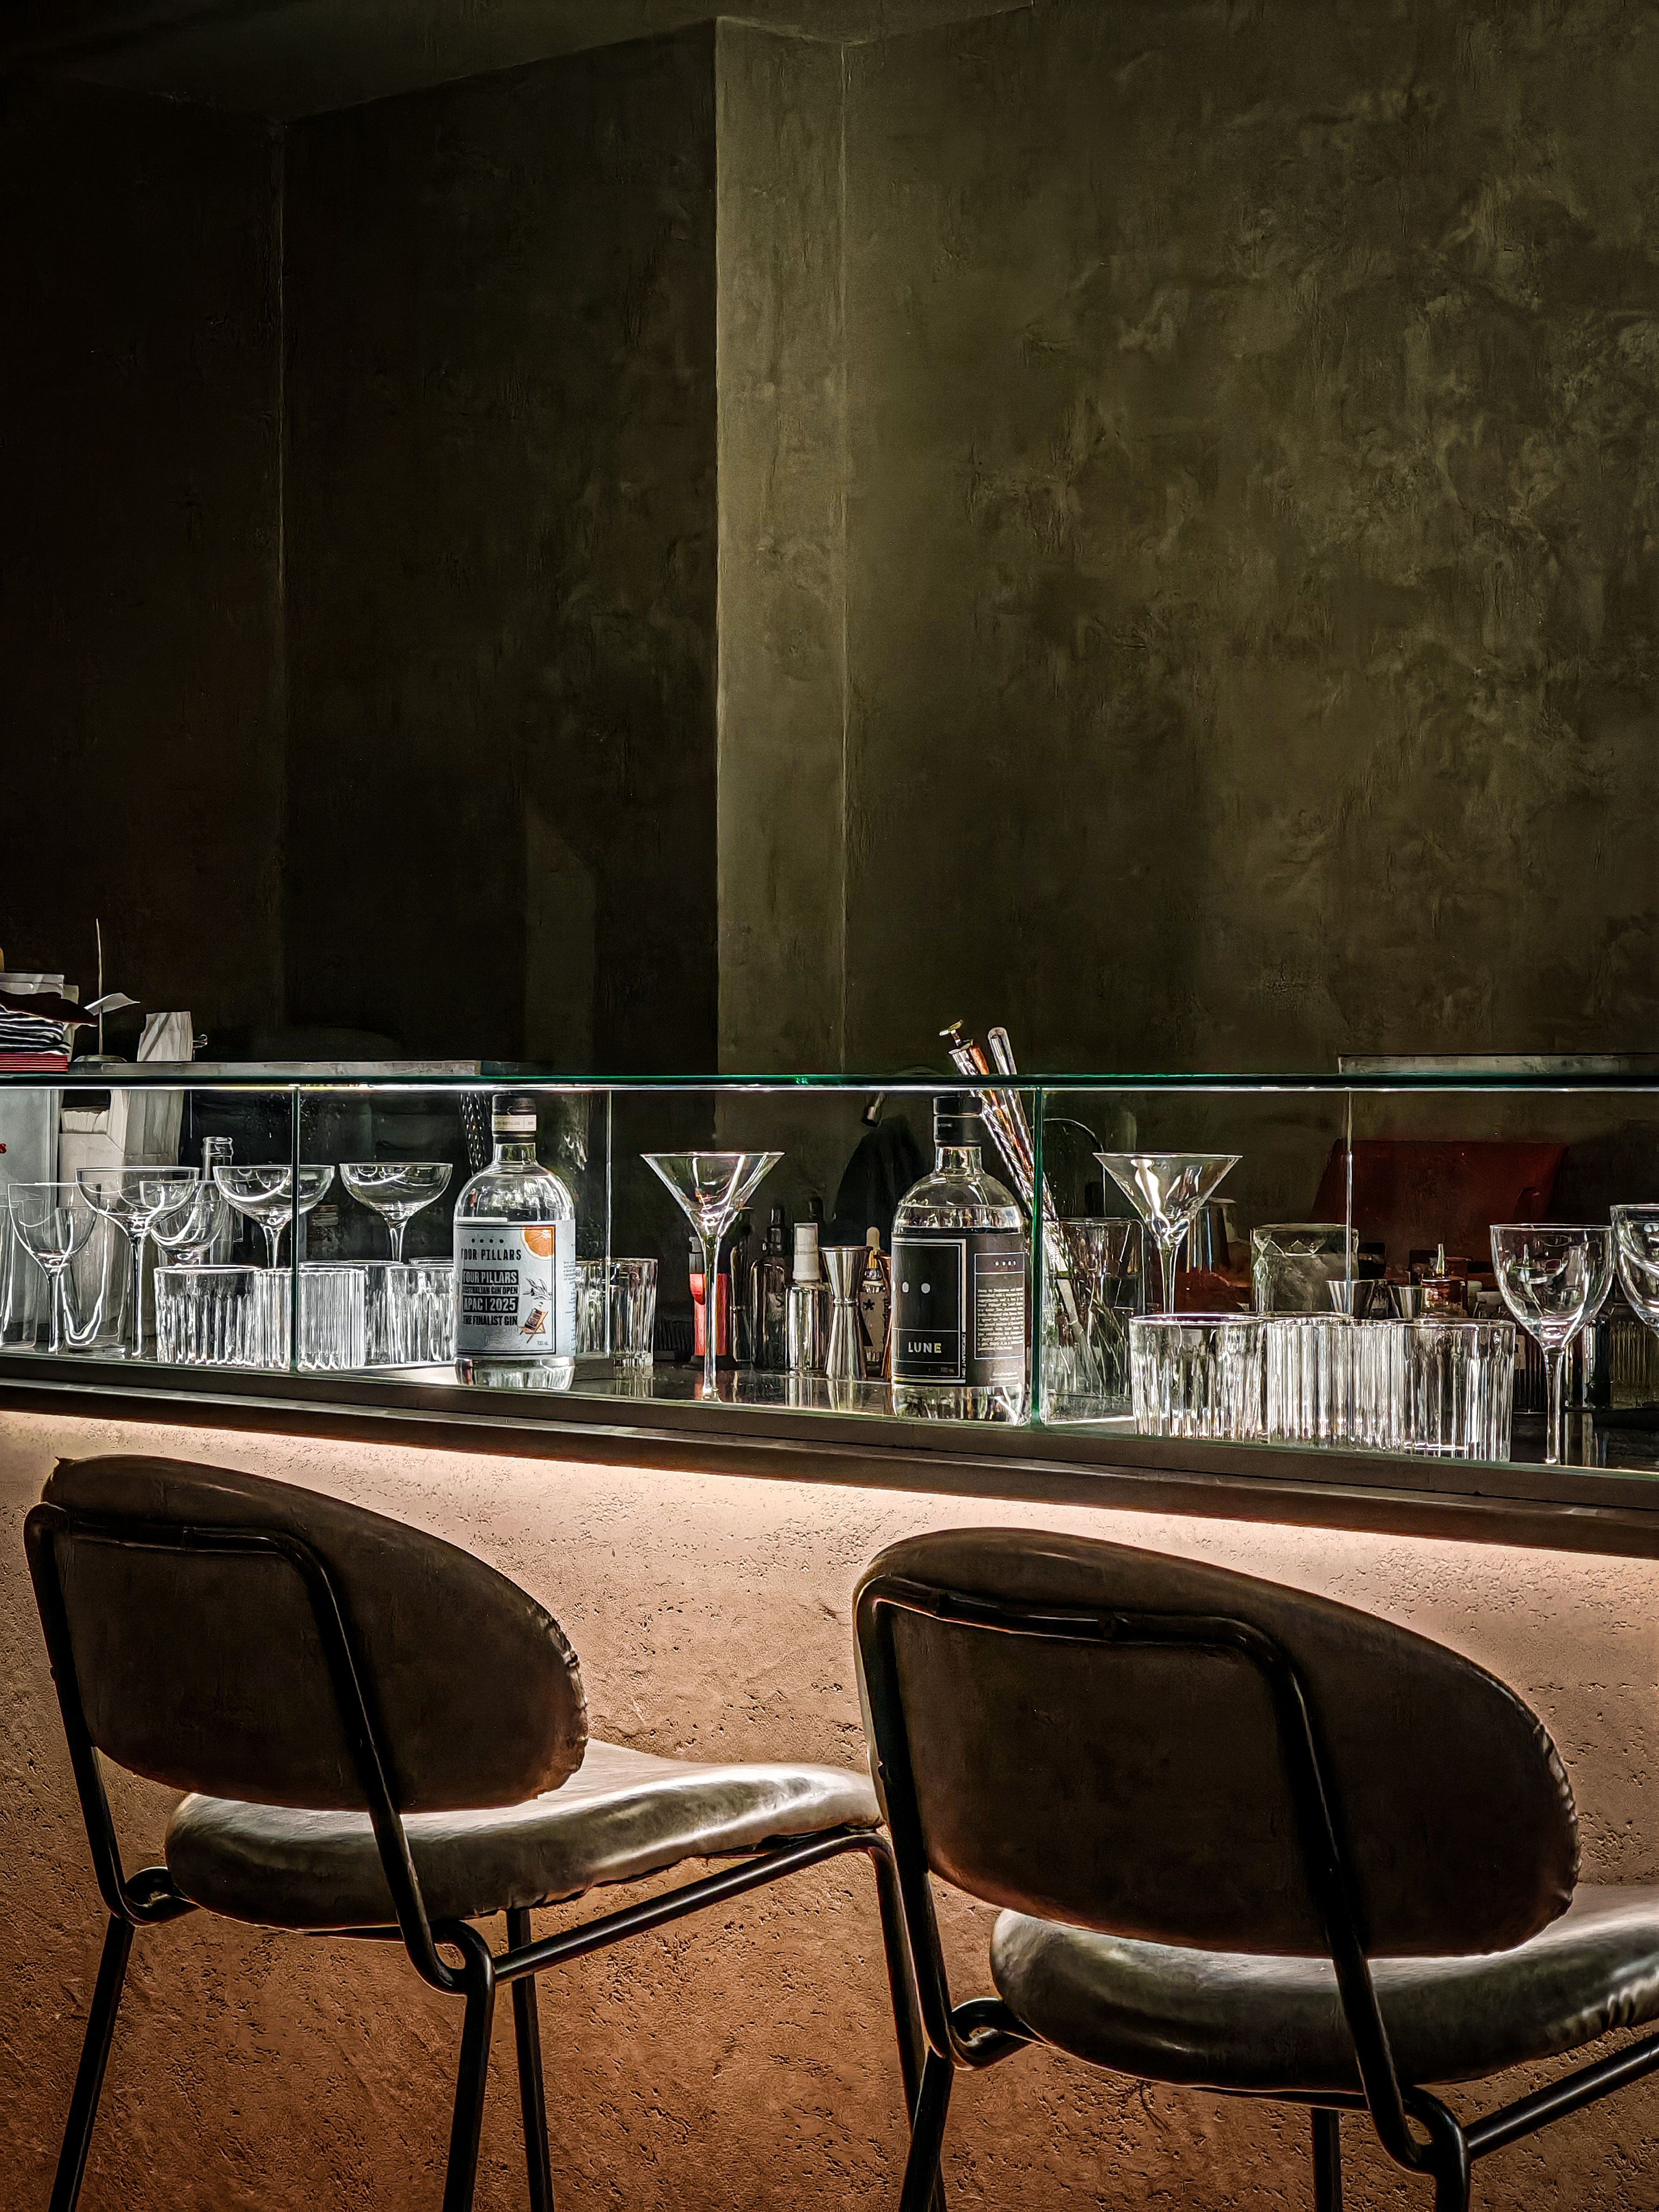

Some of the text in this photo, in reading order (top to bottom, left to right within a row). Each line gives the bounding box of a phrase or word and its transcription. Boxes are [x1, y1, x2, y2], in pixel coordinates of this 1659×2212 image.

[461, 1248, 521, 1260] FOUR PILLARS
[463, 1271, 517, 1284] FOUR PILLARS
[502, 1286, 518, 1294] OPEN
[464, 1298, 516, 1311] APAC 2025
[504, 1316, 518, 1326] GIN
[908, 1341, 942, 1353] LUNE
